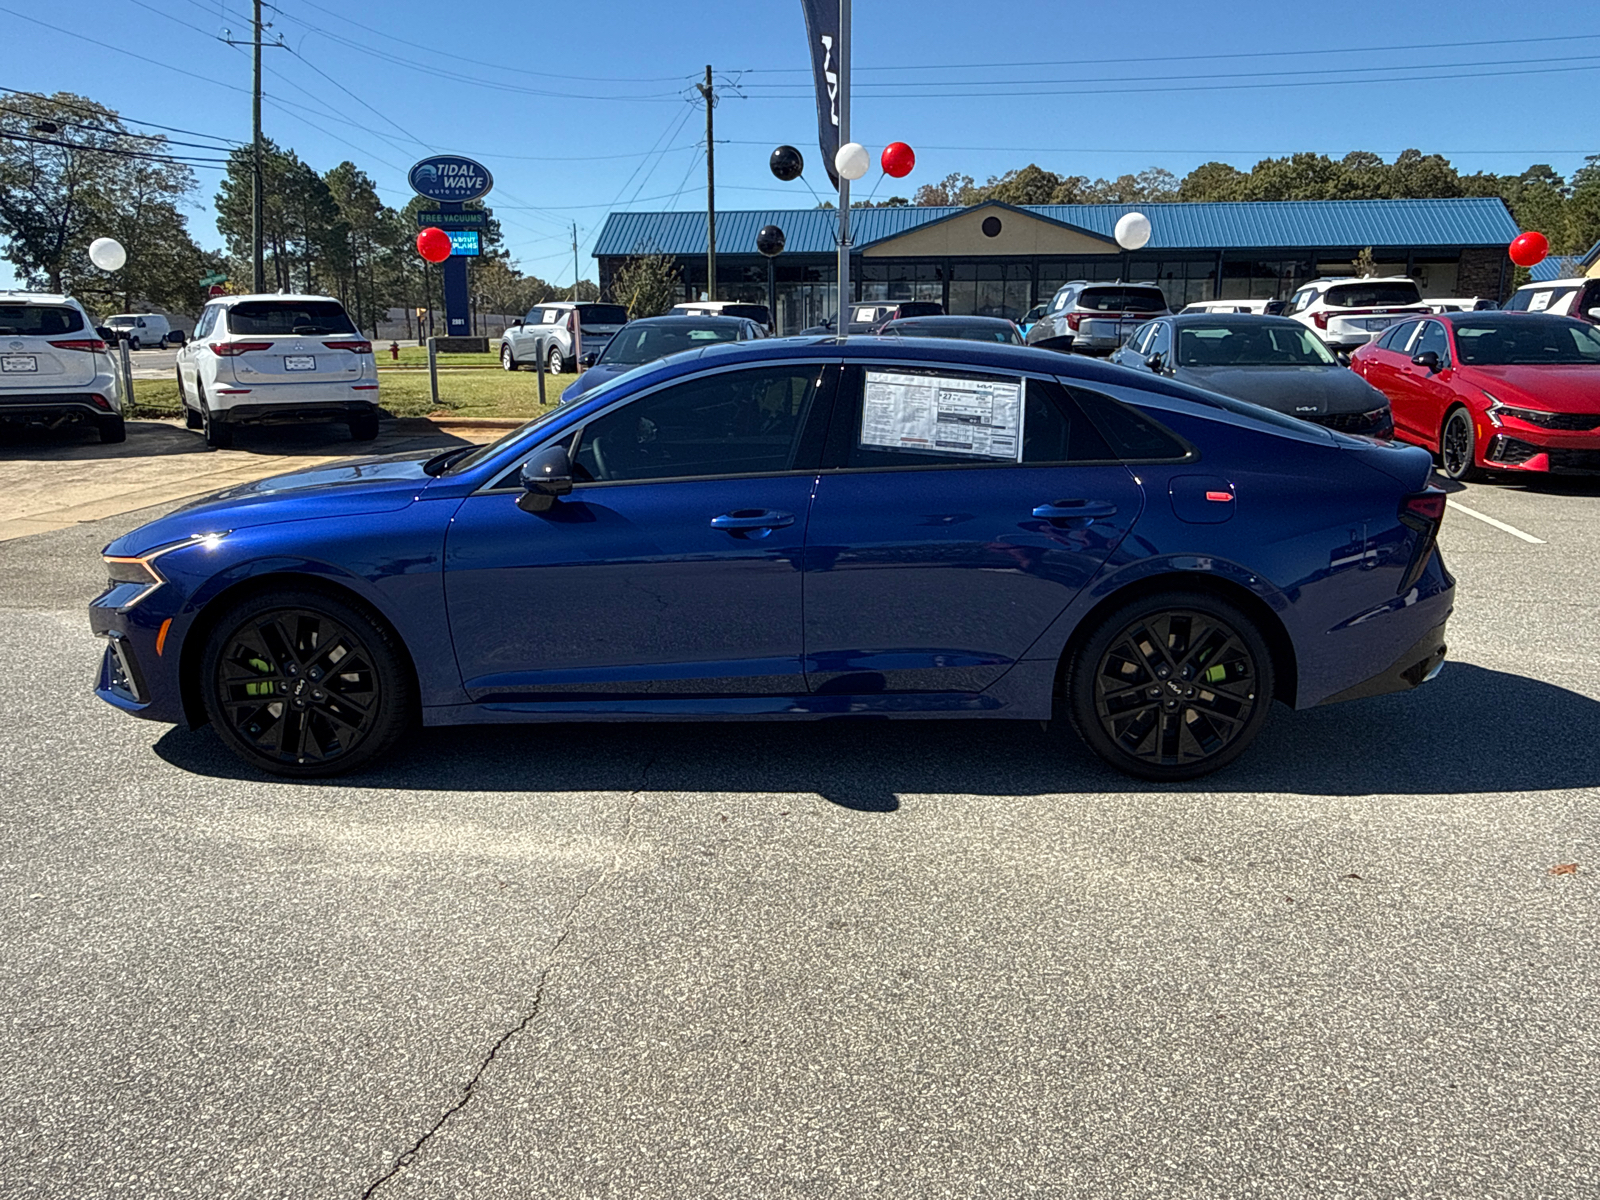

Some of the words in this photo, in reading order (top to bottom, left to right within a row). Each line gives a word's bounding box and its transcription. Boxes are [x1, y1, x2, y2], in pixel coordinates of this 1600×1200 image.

[437, 164, 475, 176] TIDAL
[444, 177, 483, 188] WAVE
[421, 214, 442, 222] FREE
[443, 214, 482, 223] VACUUMS
